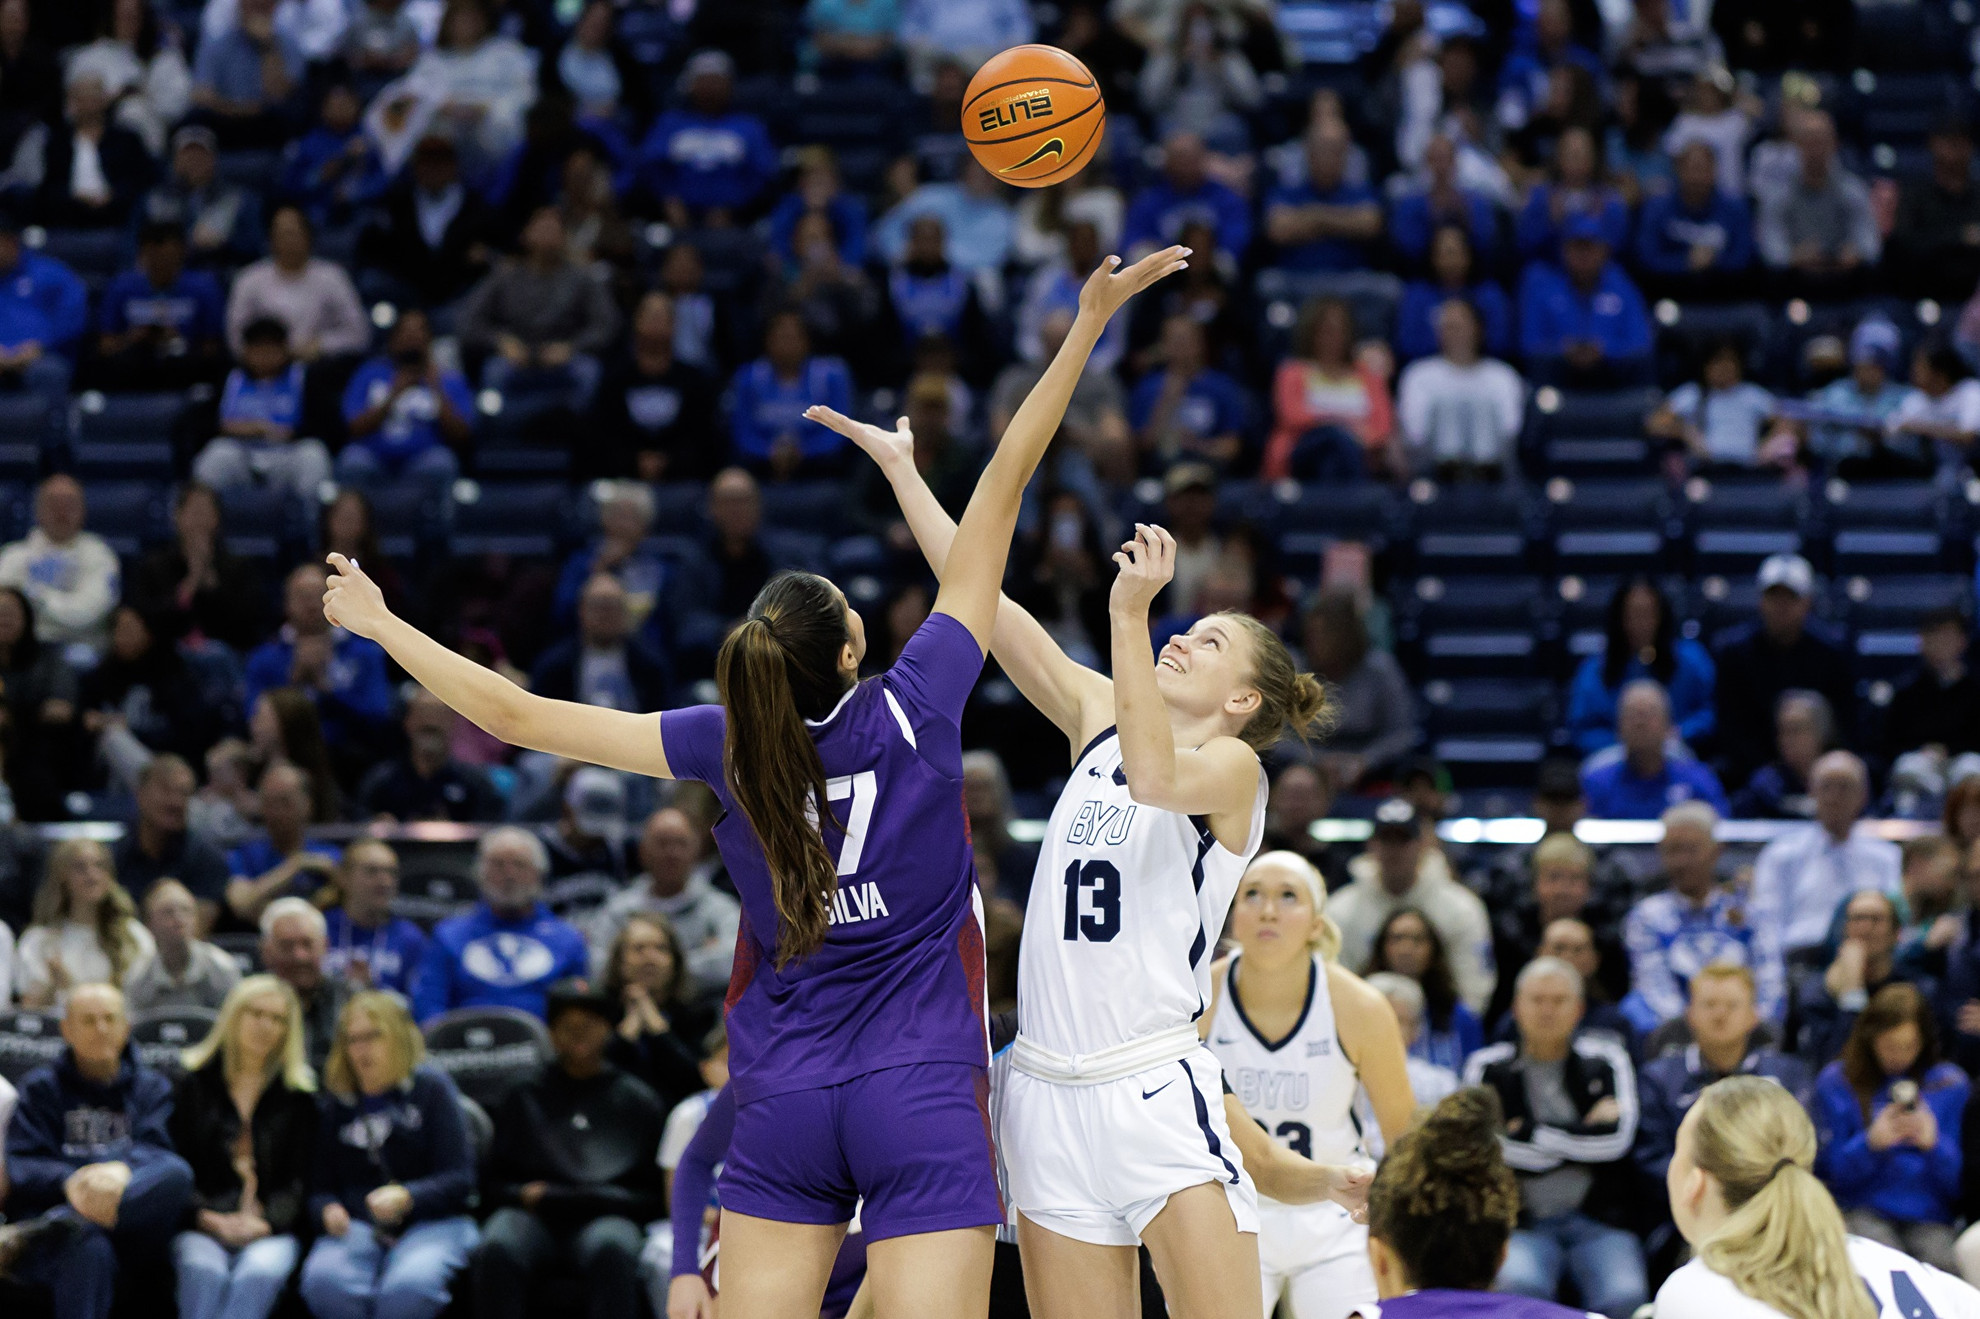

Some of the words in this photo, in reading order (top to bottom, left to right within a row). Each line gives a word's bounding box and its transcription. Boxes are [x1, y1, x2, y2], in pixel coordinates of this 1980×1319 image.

[978, 95, 1054, 133] ELITE
[804, 770, 878, 877] 7
[1066, 800, 1138, 846] BYU
[1063, 858, 1121, 943] 13
[1236, 1067, 1310, 1112] BYU
[1252, 1118, 1313, 1161] 3
